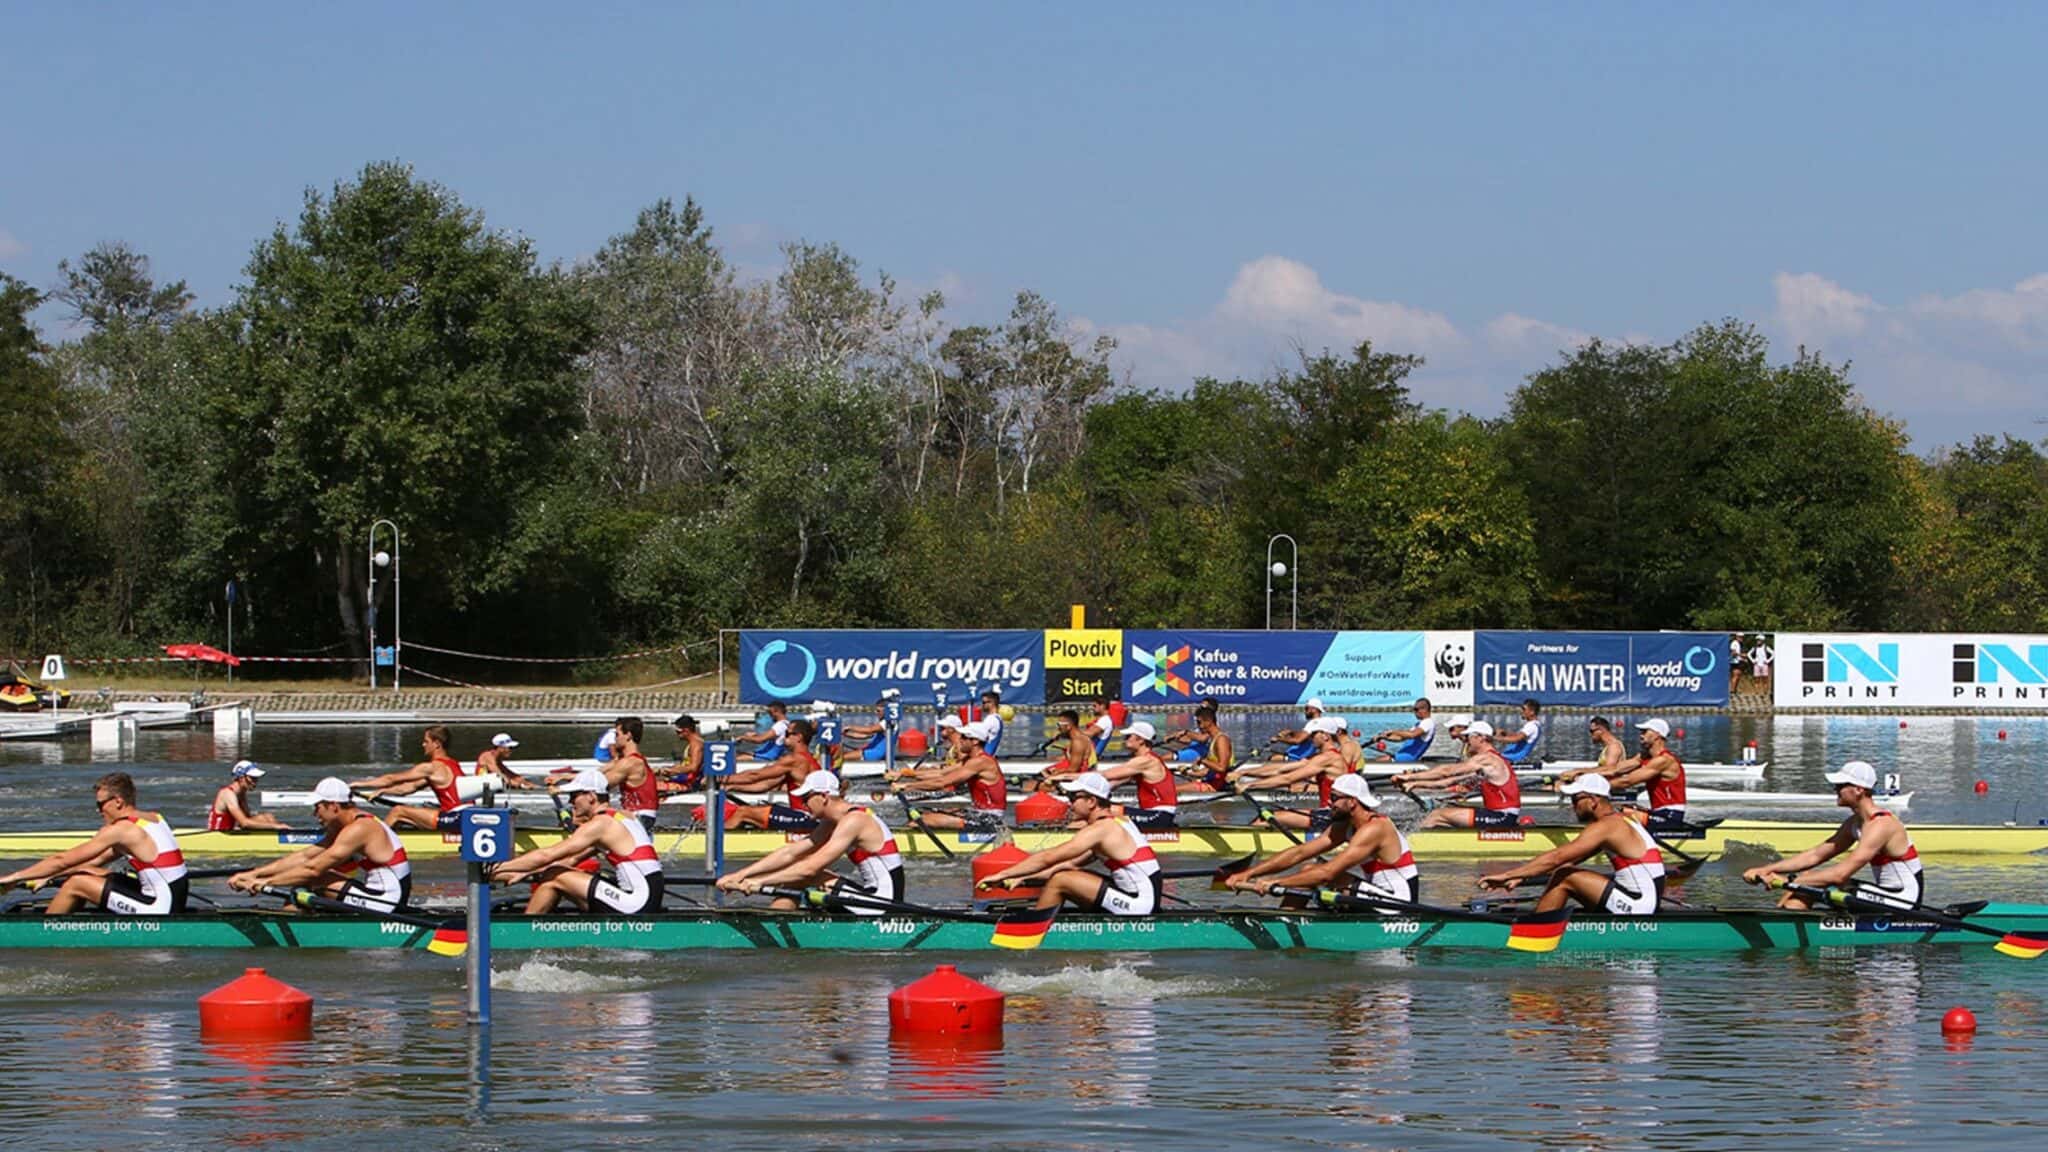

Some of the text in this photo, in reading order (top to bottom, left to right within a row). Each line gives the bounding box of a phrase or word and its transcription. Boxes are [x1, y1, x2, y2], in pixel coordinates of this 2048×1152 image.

[1050, 640, 1117, 658] Plovdiv
[1528, 643, 1580, 653] Partners for
[1194, 649, 1238, 663] Kafue
[1345, 653, 1382, 662] Support
[47, 658, 58, 676] 0
[825, 651, 1031, 686] world rowing
[1194, 665, 1307, 682] River & Rowing
[1636, 660, 1683, 676] world
[1481, 663, 1625, 692] CLEAN WATER
[1646, 675, 1701, 692] rowing
[1062, 678, 1104, 695] Start
[1193, 681, 1246, 695] Centre
[1435, 680, 1464, 690] WWF
[1802, 686, 1899, 698] PRINT
[1329, 689, 1412, 699] worldrowing.com
[1953, 686, 2048, 699] PRINT
[889, 708, 899, 720] 3
[820, 727, 834, 742] 4
[711, 752, 727, 771] 5
[1889, 774, 1897, 789] 2
[473, 828, 496, 858] 6
[604, 887, 620, 901] GER
[116, 900, 137, 913] GER
[1111, 897, 1131, 911] GER
[1615, 899, 1633, 913] GER
[43, 919, 160, 934] Pioneering for You
[531, 919, 601, 935] Pioneering
[605, 920, 623, 932] for
[1107, 920, 1126, 932] for
[1129, 920, 1155, 932] You
[1610, 920, 1630, 932] for
[1633, 920, 1658, 932] You
[1823, 916, 1854, 928] GER
